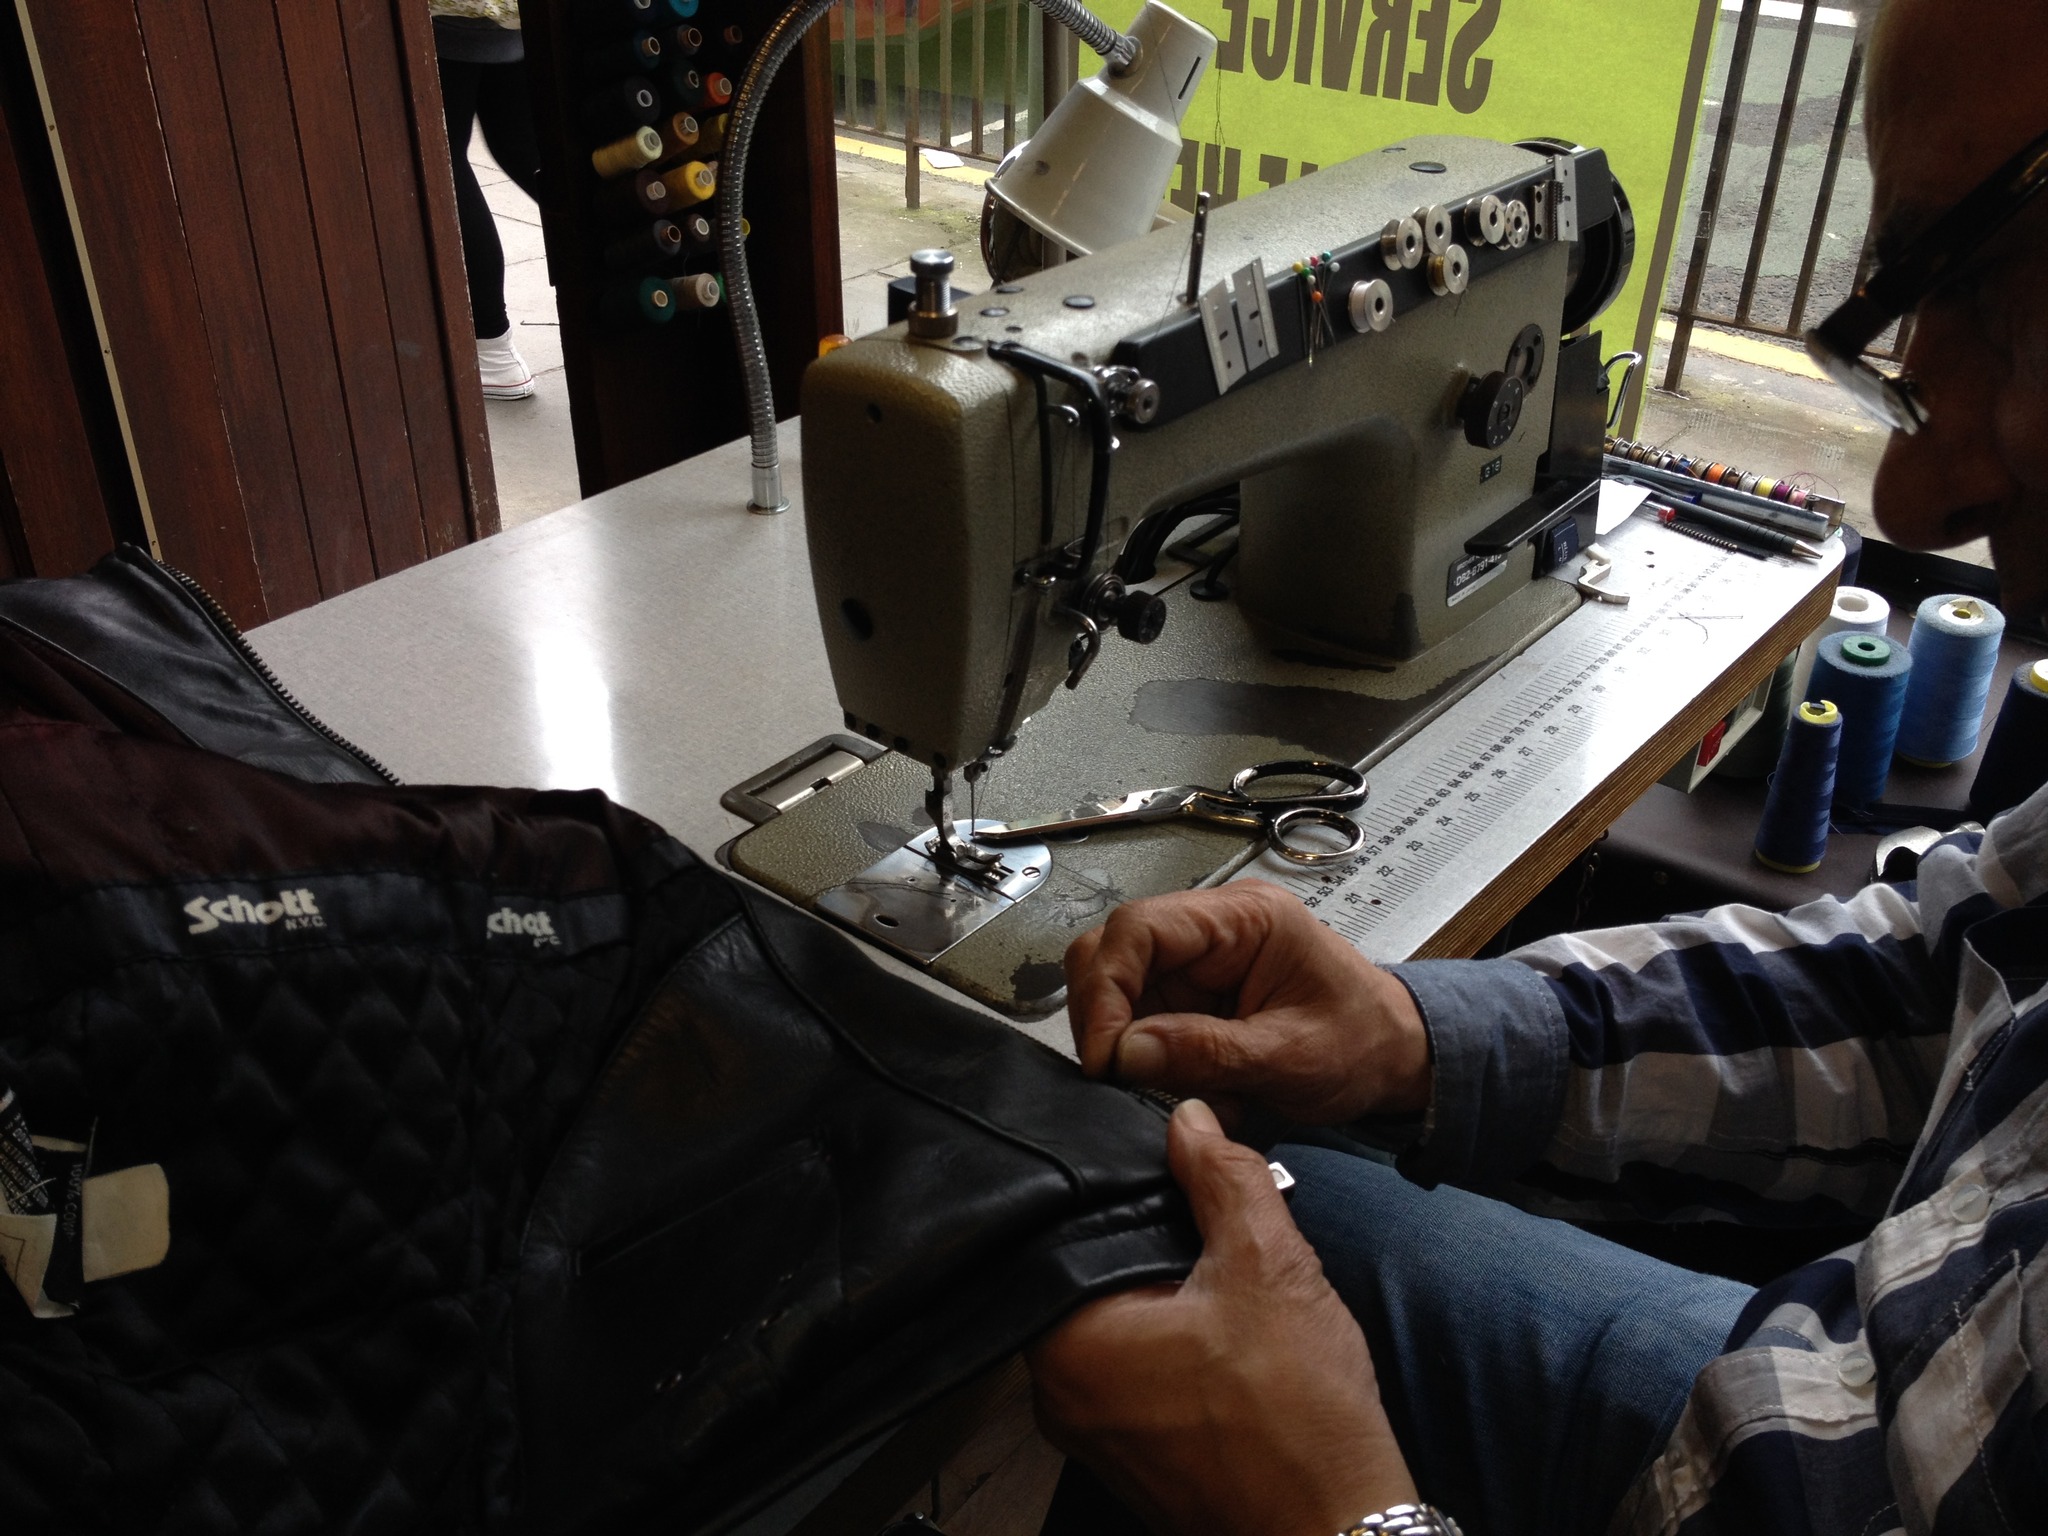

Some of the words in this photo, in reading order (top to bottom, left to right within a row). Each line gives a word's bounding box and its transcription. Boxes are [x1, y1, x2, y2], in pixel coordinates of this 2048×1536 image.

[1304, 896, 1321, 908] 52
[1317, 885, 1334, 897] 53
[1330, 875, 1346, 887] 54
[1342, 865, 1359, 876] 55
[1354, 855, 1370, 866] 56
[1365, 845, 1383, 856] 57
[1378, 835, 1395, 846] 58
[1390, 825, 1407, 836] 59
[1402, 816, 1418, 826] 60
[1413, 807, 1429, 816] 61
[1424, 798, 1440, 807] 62
[1436, 788, 1451, 798] 63
[1447, 779, 1462, 788] 64
[1469, 761, 1484, 770] 66
[1480, 752, 1495, 761] 67
[1500, 736, 1514, 744] 69
[1509, 726, 1525, 735] 70
[1519, 719, 1534, 727] 71
[1529, 710, 1545, 719] 72
[1539, 702, 1554, 711] 73
[1549, 694, 1564, 703] 74
[1558, 687, 1573, 695] 75
[1567, 679, 1583, 687] 76
[1344, 892, 1362, 904] 21
[1376, 865, 1394, 877] 22
[1406, 840, 1424, 852] 23
[1436, 815, 1453, 826] 24
[1464, 791, 1480, 802] 25
[1491, 769, 1507, 779] 26
[1518, 746, 1533, 757] 27
[1543, 725, 1559, 735] 28
[1567, 704, 1583, 714] 29
[183, 888, 320, 935] Schott
